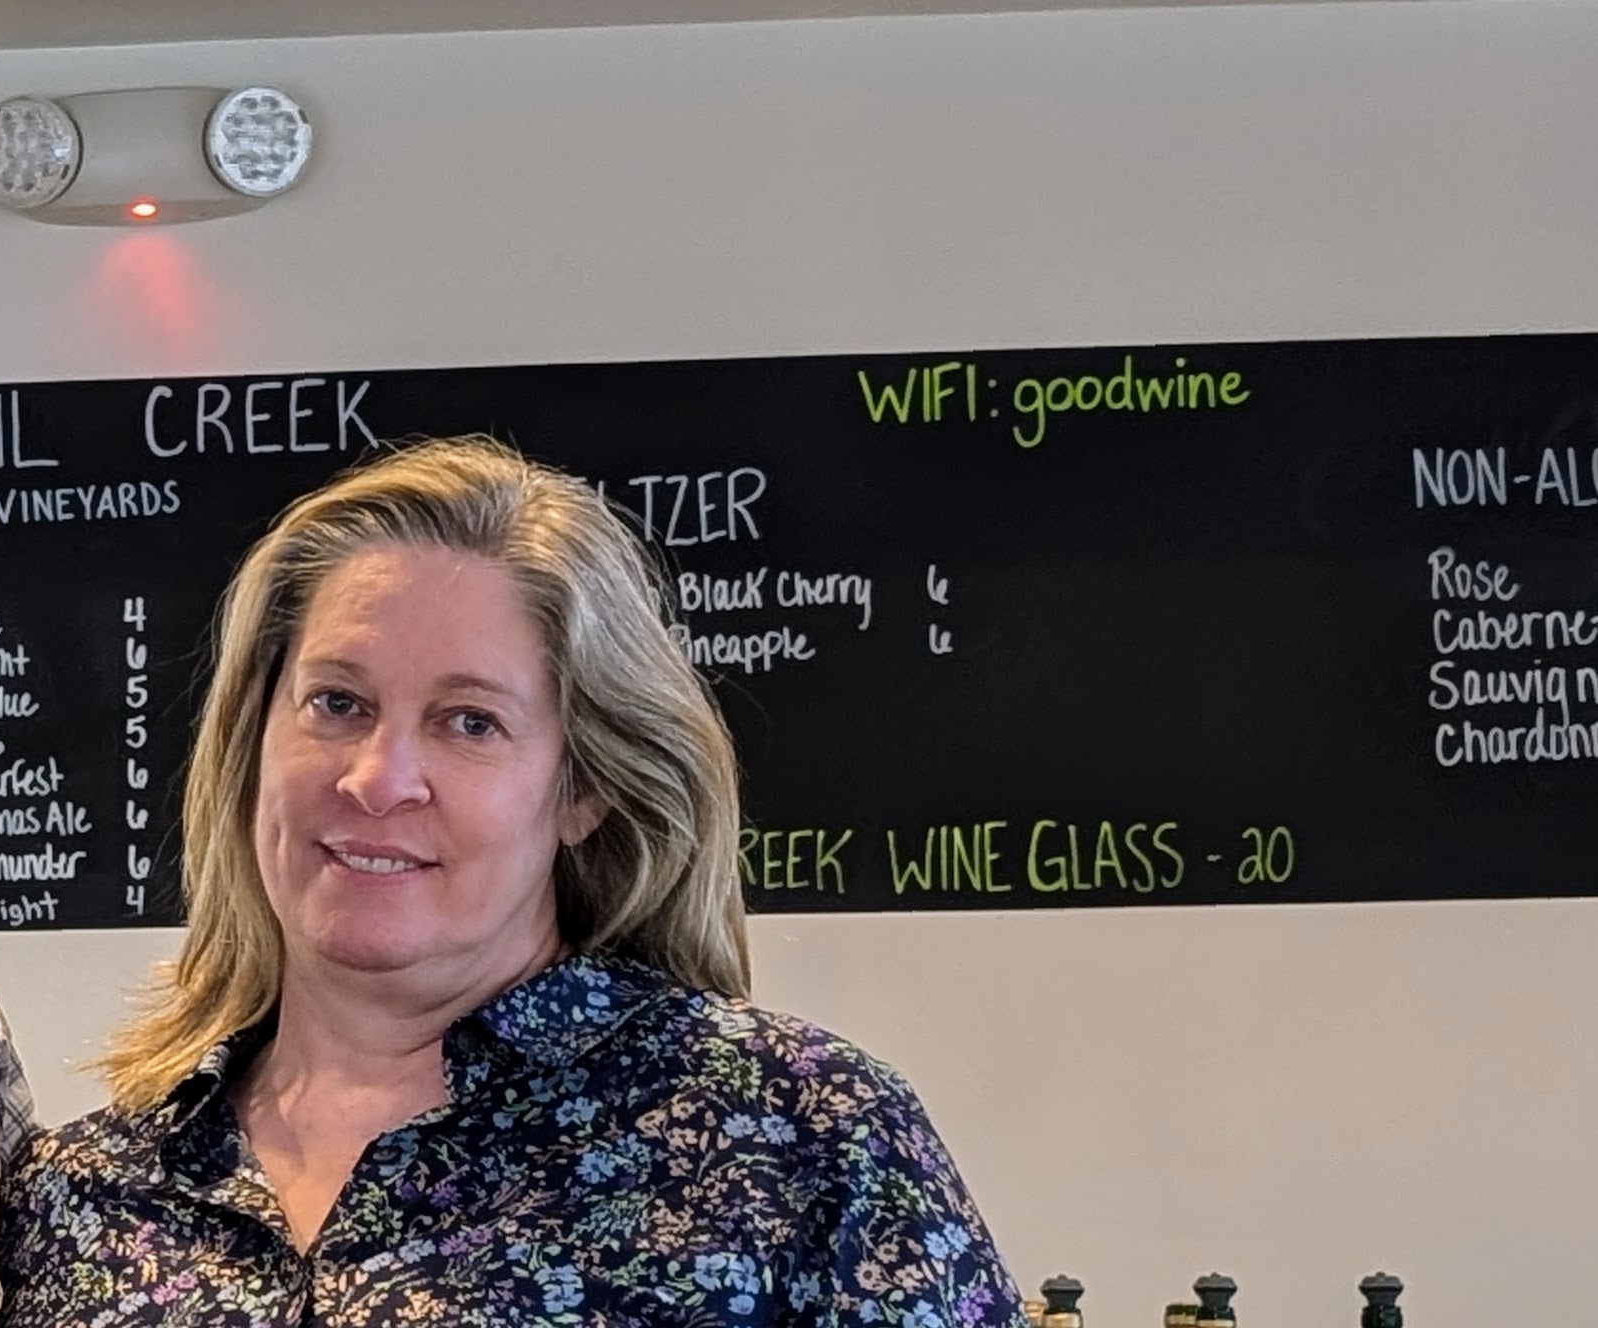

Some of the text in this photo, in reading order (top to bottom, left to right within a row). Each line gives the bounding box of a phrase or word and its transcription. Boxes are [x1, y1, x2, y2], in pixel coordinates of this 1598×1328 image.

[144, 378, 380, 457] CREEK
[1012, 356, 1251, 448] goodwine
[598, 466, 767, 547] TZER
[1427, 546, 1522, 602] Rose
[123, 596, 147, 632] 4
[776, 570, 872, 631] Cherry
[927, 564, 949, 605] 6
[928, 624, 953, 654] 6
[1432, 608, 1598, 654] Caberne
[125, 636, 148, 670] 6
[125, 674, 148, 709] 5
[125, 714, 148, 749] 5
[126, 757, 149, 790] 6
[45, 800, 92, 837] Ale
[126, 799, 149, 830] 6
[127, 843, 151, 880] 6
[738, 826, 853, 895] REEK
[886, 819, 1012, 895] WINE
[1027, 818, 1187, 894] GLASS
[1237, 826, 1297, 885] 20
[125, 884, 146, 916] 4
